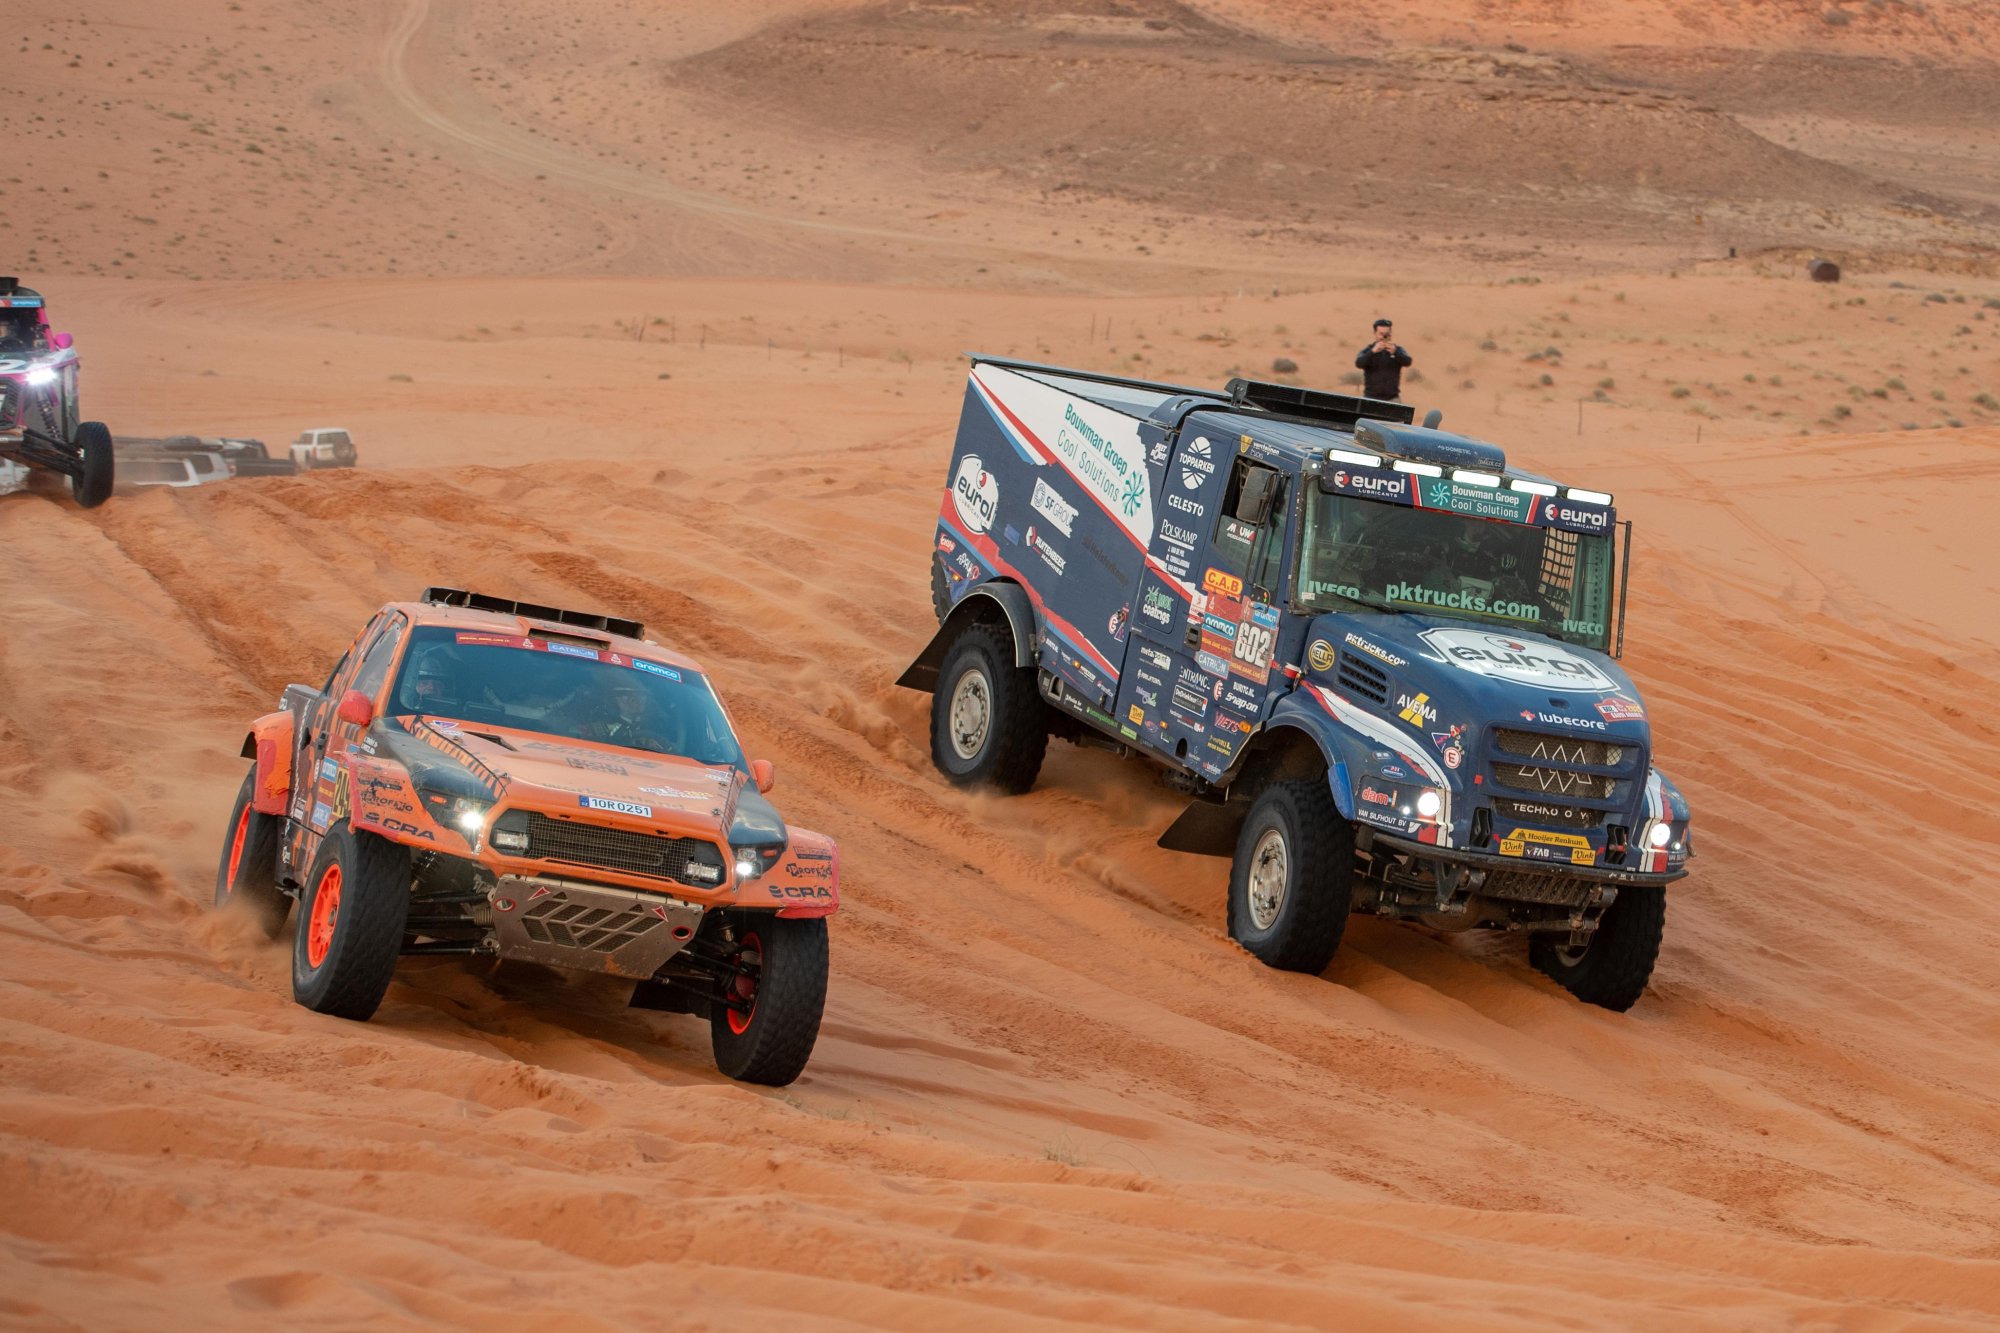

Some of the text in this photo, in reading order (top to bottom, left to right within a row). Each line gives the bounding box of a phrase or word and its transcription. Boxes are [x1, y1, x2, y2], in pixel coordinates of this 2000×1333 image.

[1065, 403, 1128, 476] Bouwman Groep
[1058, 430, 1079, 460] Cool
[1079, 451, 1120, 502] Solutions
[1180, 453, 1215, 474] TOPPARKEN
[1351, 474, 1405, 494] eurol
[1358, 488, 1398, 498] LUBRICANTS
[957, 475, 995, 521] eurol
[1168, 494, 1204, 517] CELESTO
[1452, 485, 1520, 506] Bouwman Groep
[1451, 499, 1519, 518] Cool Solutions
[1560, 508, 1607, 527] eurol
[1161, 519, 1197, 544] POLSKAMP
[1566, 521, 1600, 531] LUBRICANTS
[1035, 536, 1066, 570] RUITENBEEK
[1385, 581, 1540, 620] pktrucks.com
[1205, 617, 1234, 637] aramco
[1563, 619, 1605, 637] IVECO
[1234, 622, 1272, 669] 602
[635, 662, 679, 679] aramco
[1448, 646, 1599, 679] eurol
[1396, 694, 1437, 722] AVEMA
[1538, 712, 1606, 730] lubecore
[618, 801, 651, 816] 0251
[1358, 808, 1369, 817] VAN
[1398, 819, 1407, 827] BV
[1502, 840, 1523, 851] Vink
[1574, 850, 1595, 860] Vink
